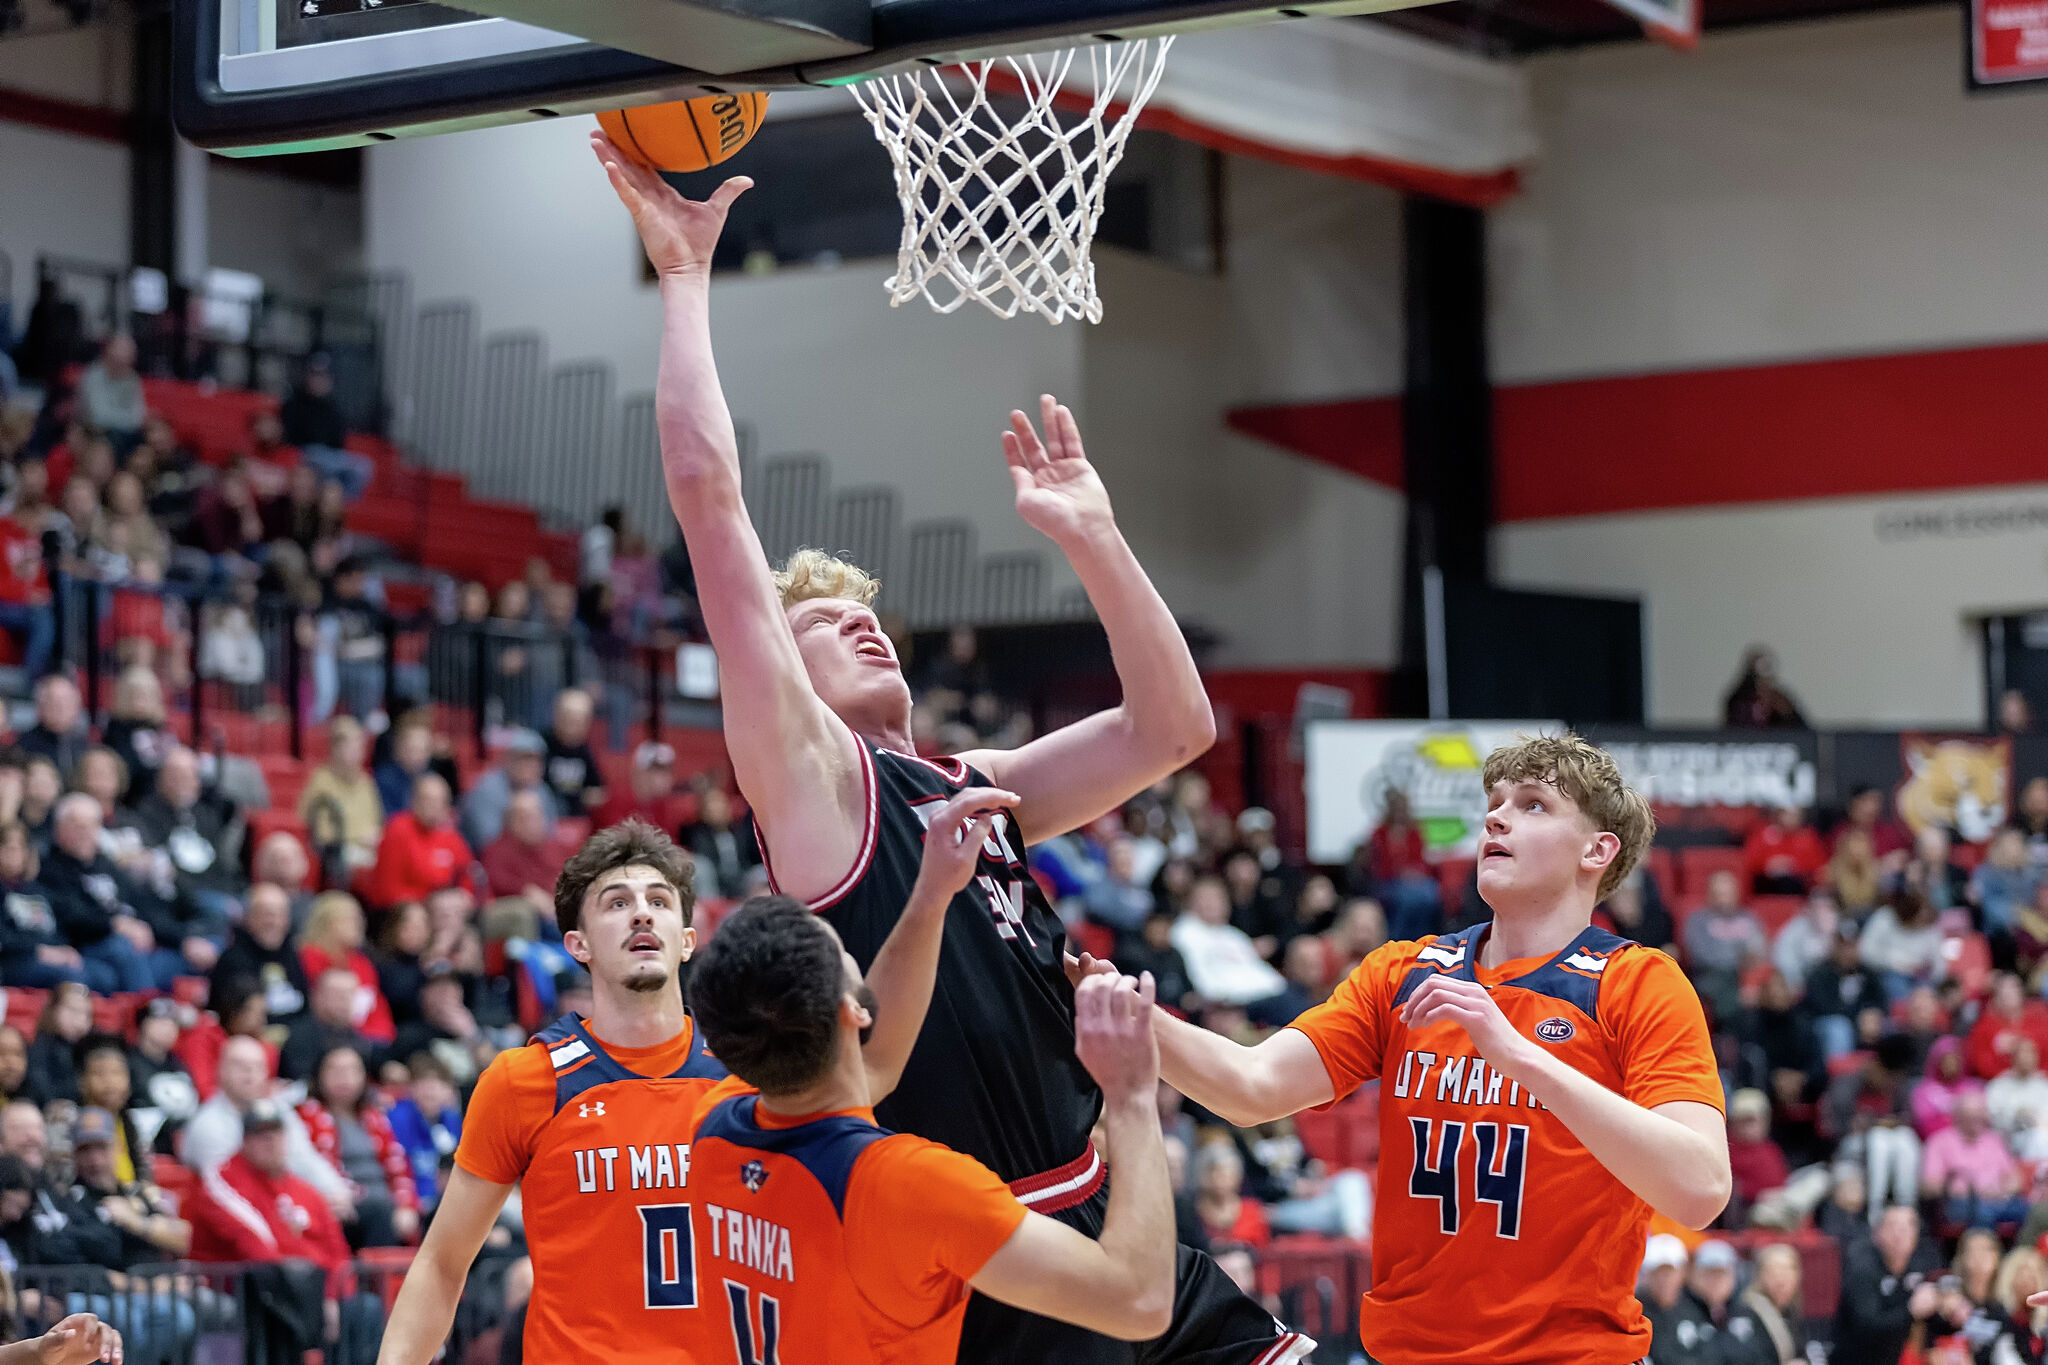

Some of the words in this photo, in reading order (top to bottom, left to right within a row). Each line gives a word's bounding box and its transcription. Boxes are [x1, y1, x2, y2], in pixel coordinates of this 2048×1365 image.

[712, 95, 745, 154] Wil
[1542, 1025, 1567, 1036] OVC
[1394, 1050, 1437, 1099] UT
[1436, 1055, 1549, 1110] MAR
[573, 1146, 619, 1193] UT
[627, 1143, 690, 1190] MAR
[1408, 1116, 1530, 1240] 44
[635, 1202, 699, 1310] 0
[706, 1202, 795, 1283] TRNKA
